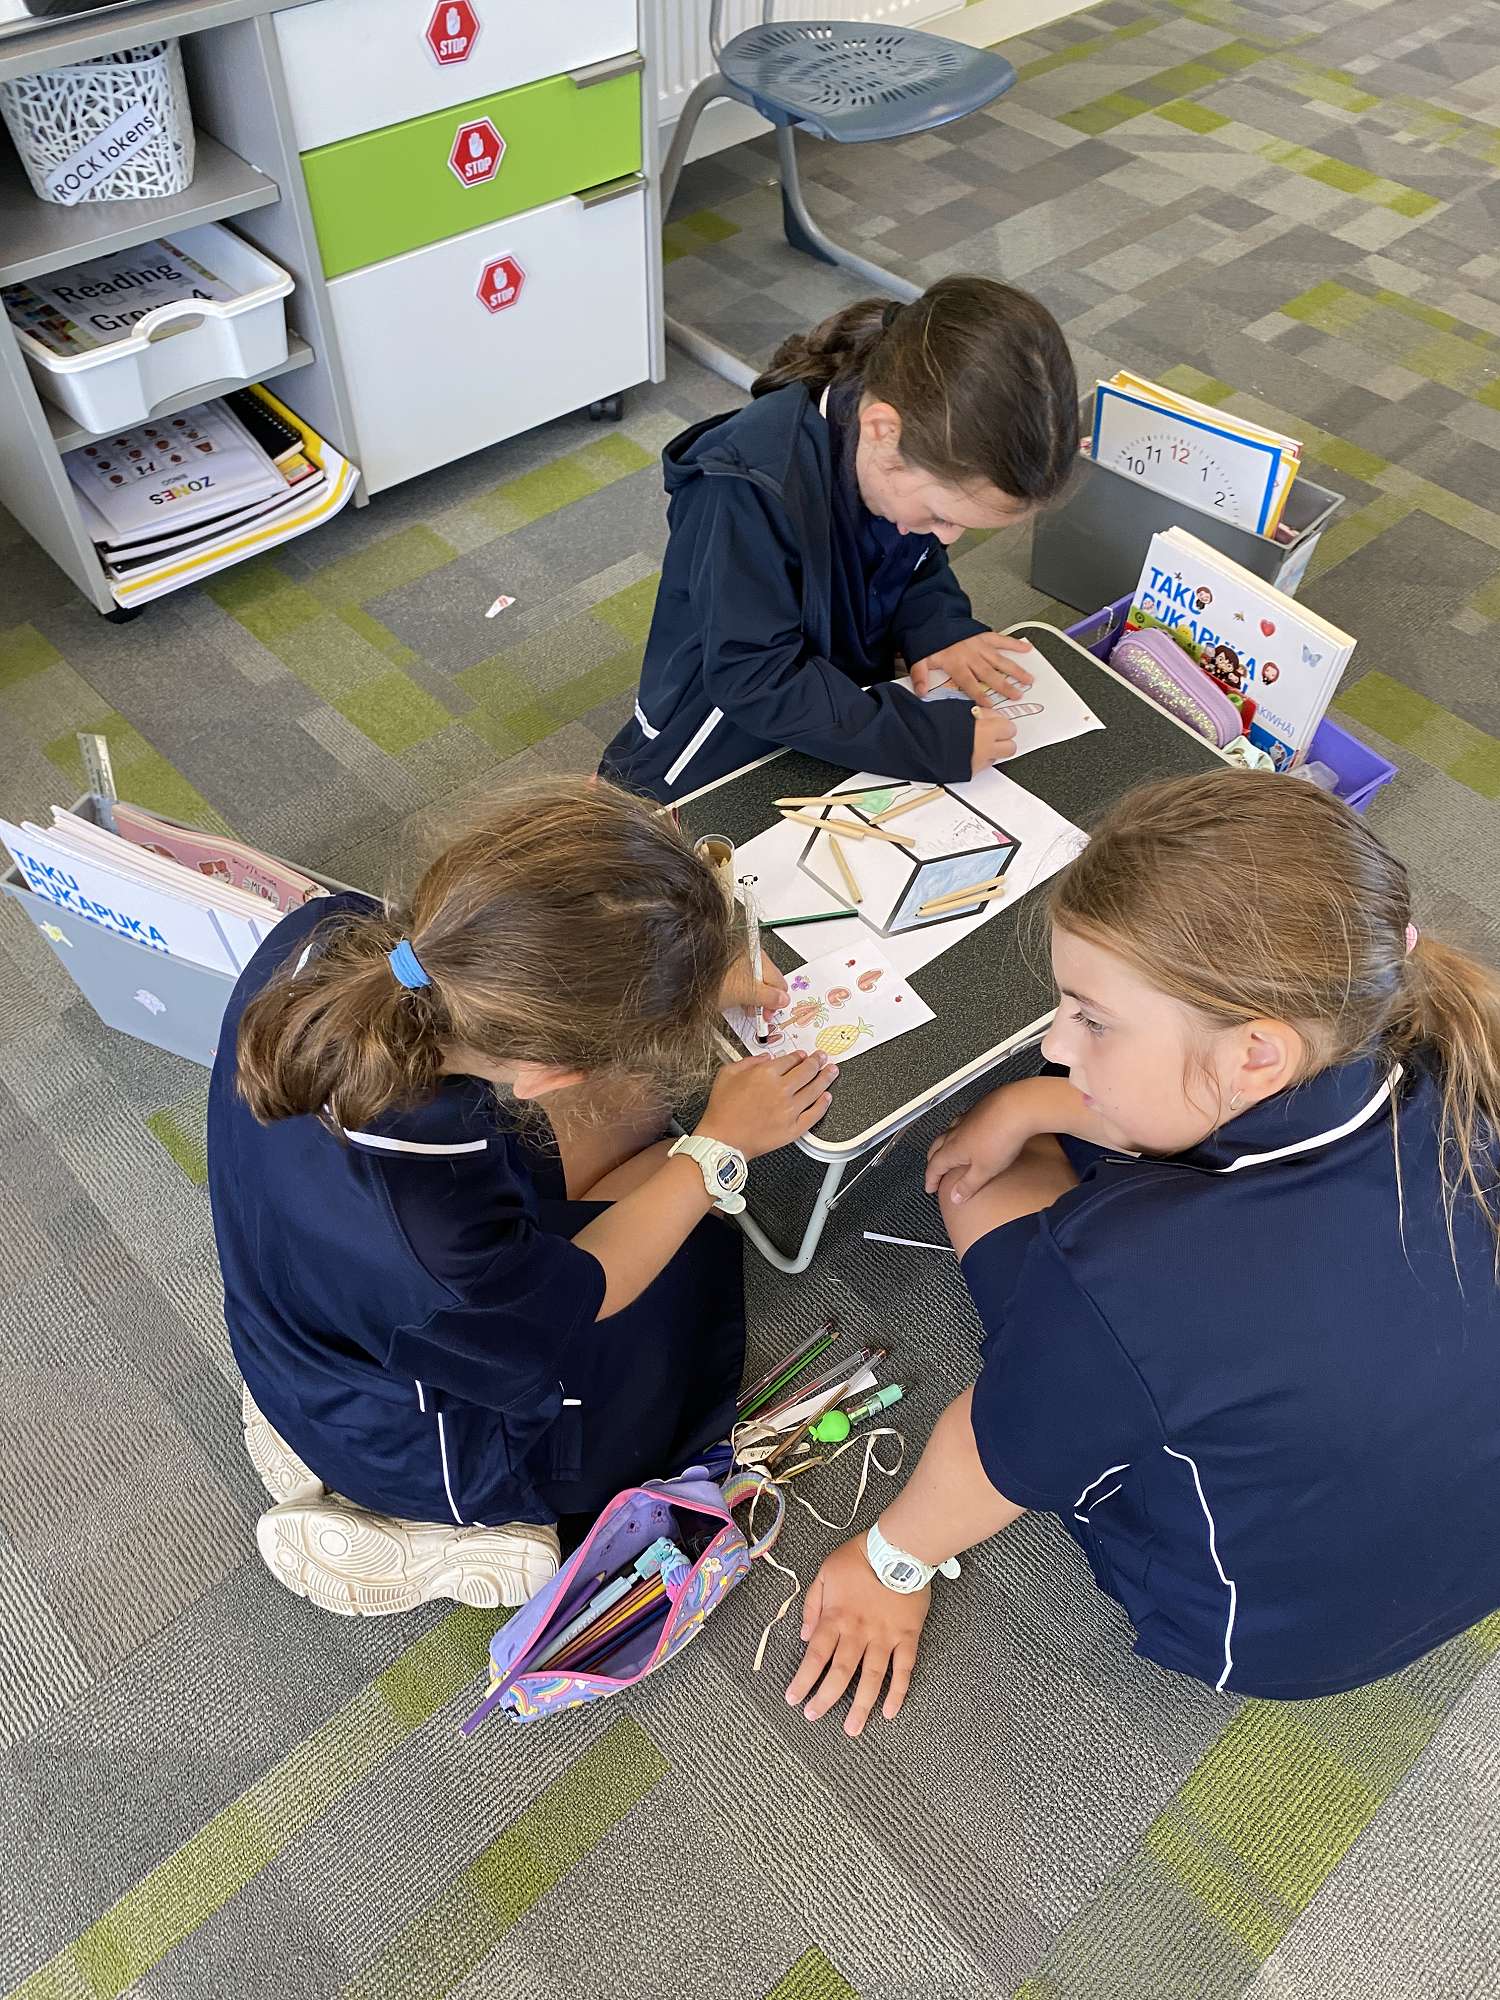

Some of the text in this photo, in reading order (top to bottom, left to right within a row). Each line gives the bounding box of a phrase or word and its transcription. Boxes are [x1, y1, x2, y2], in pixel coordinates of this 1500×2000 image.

[440, 37, 467, 56] STOP
[54, 116, 155, 199] ROCK tokens
[465, 156, 492, 177] STOP
[52, 264, 183, 303] Reading
[490, 287, 515, 307] STOP
[90, 301, 178, 331] Gro
[1146, 445, 1161, 464] 11
[1170, 445, 1190, 464] 12
[1127, 456, 1145, 475] 10
[1201, 467, 1208, 482] 1
[149, 476, 216, 505] ZONES
[1214, 491, 1226, 507] 2
[11, 848, 79, 891] TAKU
[26, 870, 169, 946] PUKAPUKA
